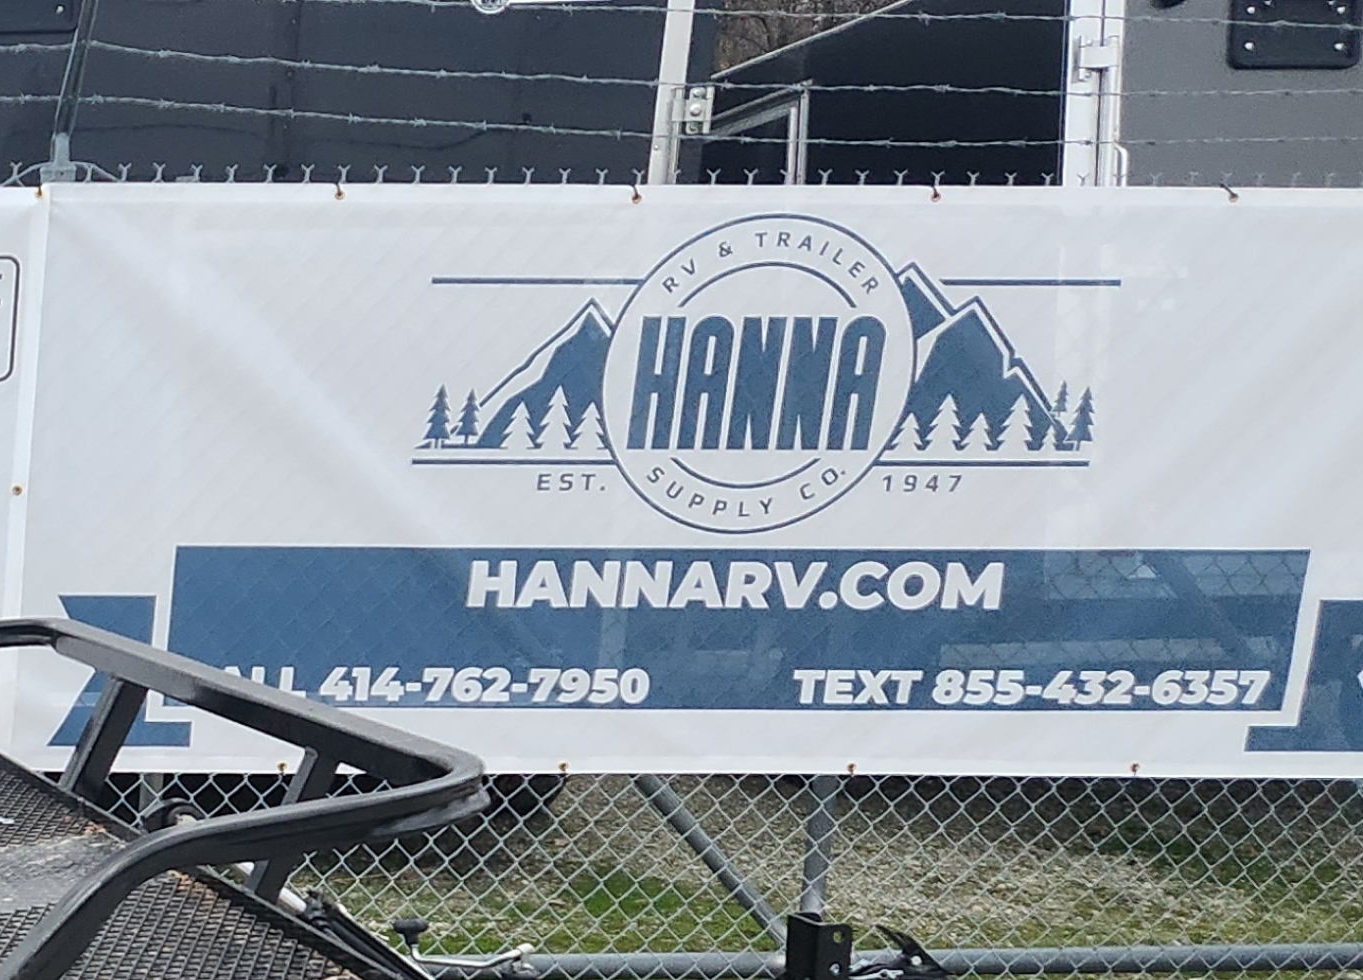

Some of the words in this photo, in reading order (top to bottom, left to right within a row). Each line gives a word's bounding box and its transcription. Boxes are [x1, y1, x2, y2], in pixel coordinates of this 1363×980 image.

[662, 260, 697, 294] RV
[755, 231, 880, 294] TRAILER
[626, 315, 887, 450] HANNA
[537, 473, 607, 492] EST.
[646, 466, 774, 517] SUPPLY
[882, 475, 963, 493] 1947
[466, 559, 1006, 610] HANNARV.COM
[319, 667, 650, 704] 414-762-7950
[793, 669, 925, 705] TEXT
[931, 670, 1270, 706] 855-432-6357
